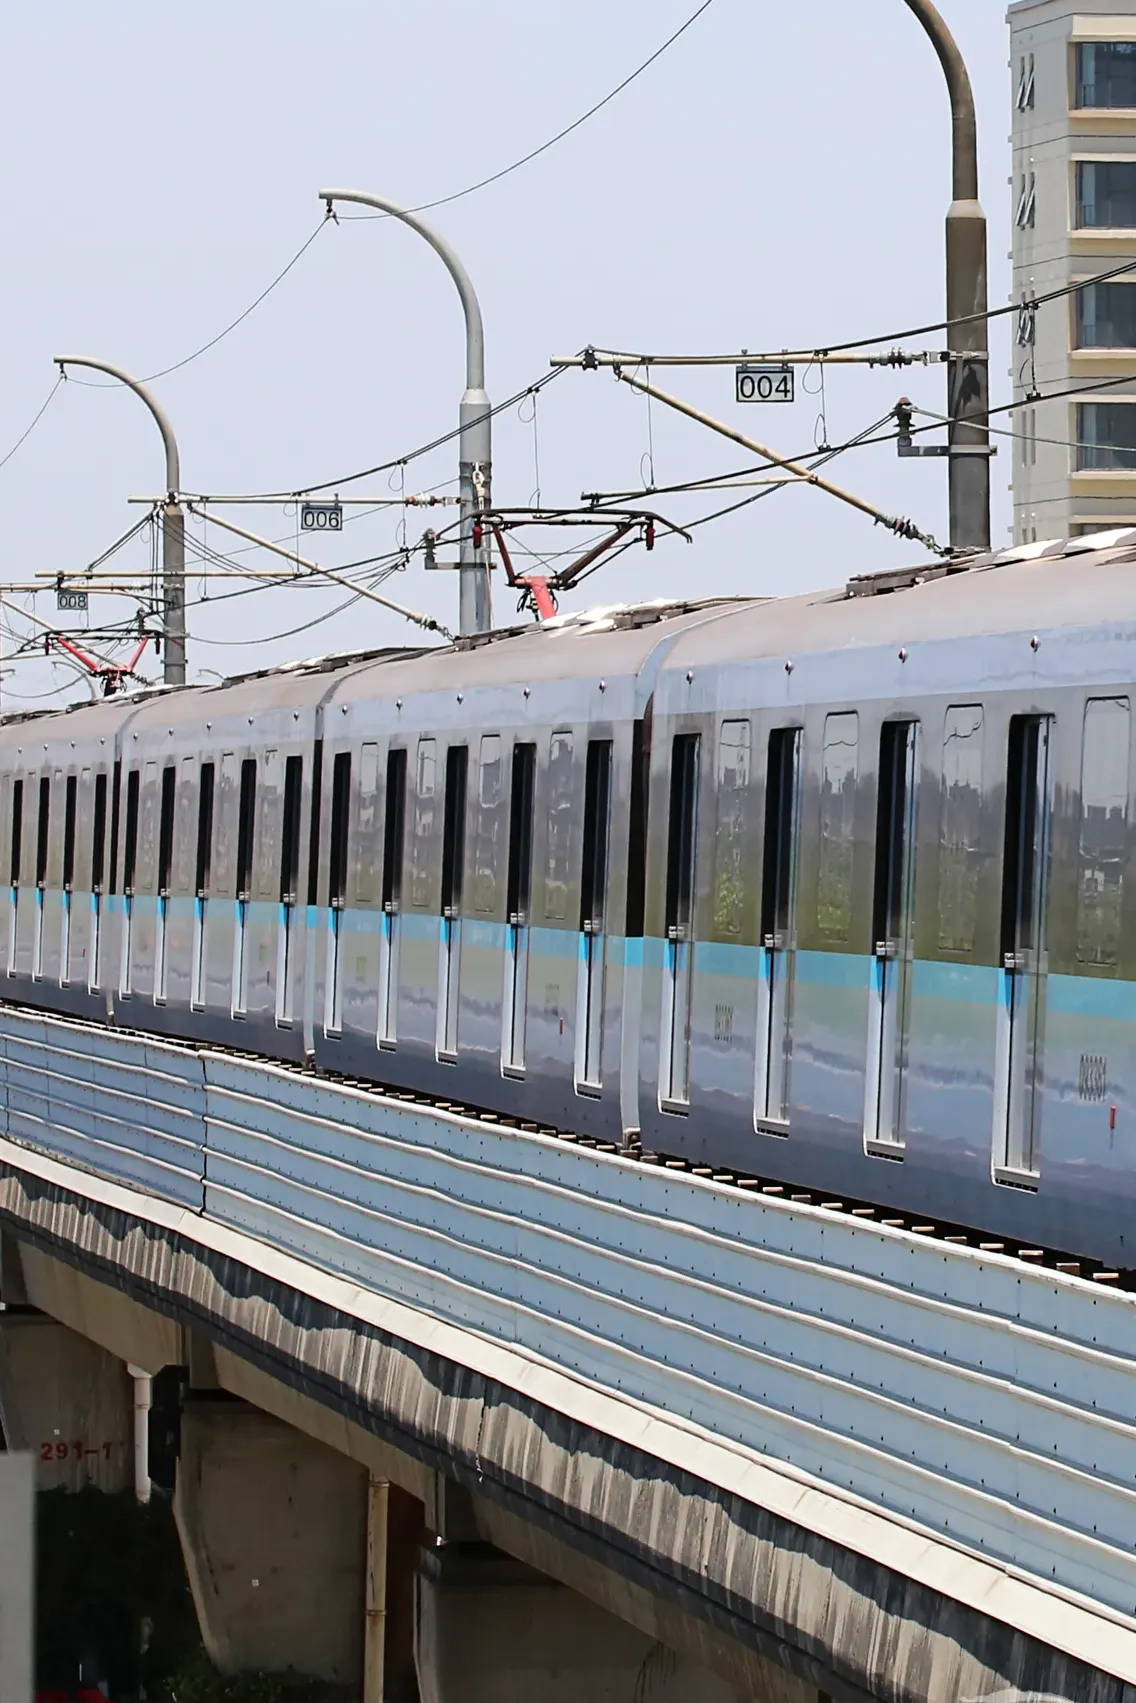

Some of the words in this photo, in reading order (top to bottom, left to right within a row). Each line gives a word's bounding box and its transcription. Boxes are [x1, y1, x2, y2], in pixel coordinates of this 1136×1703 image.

[740, 375, 790, 399] 004
[304, 510, 339, 528] 006
[60, 594, 86, 608] 008
